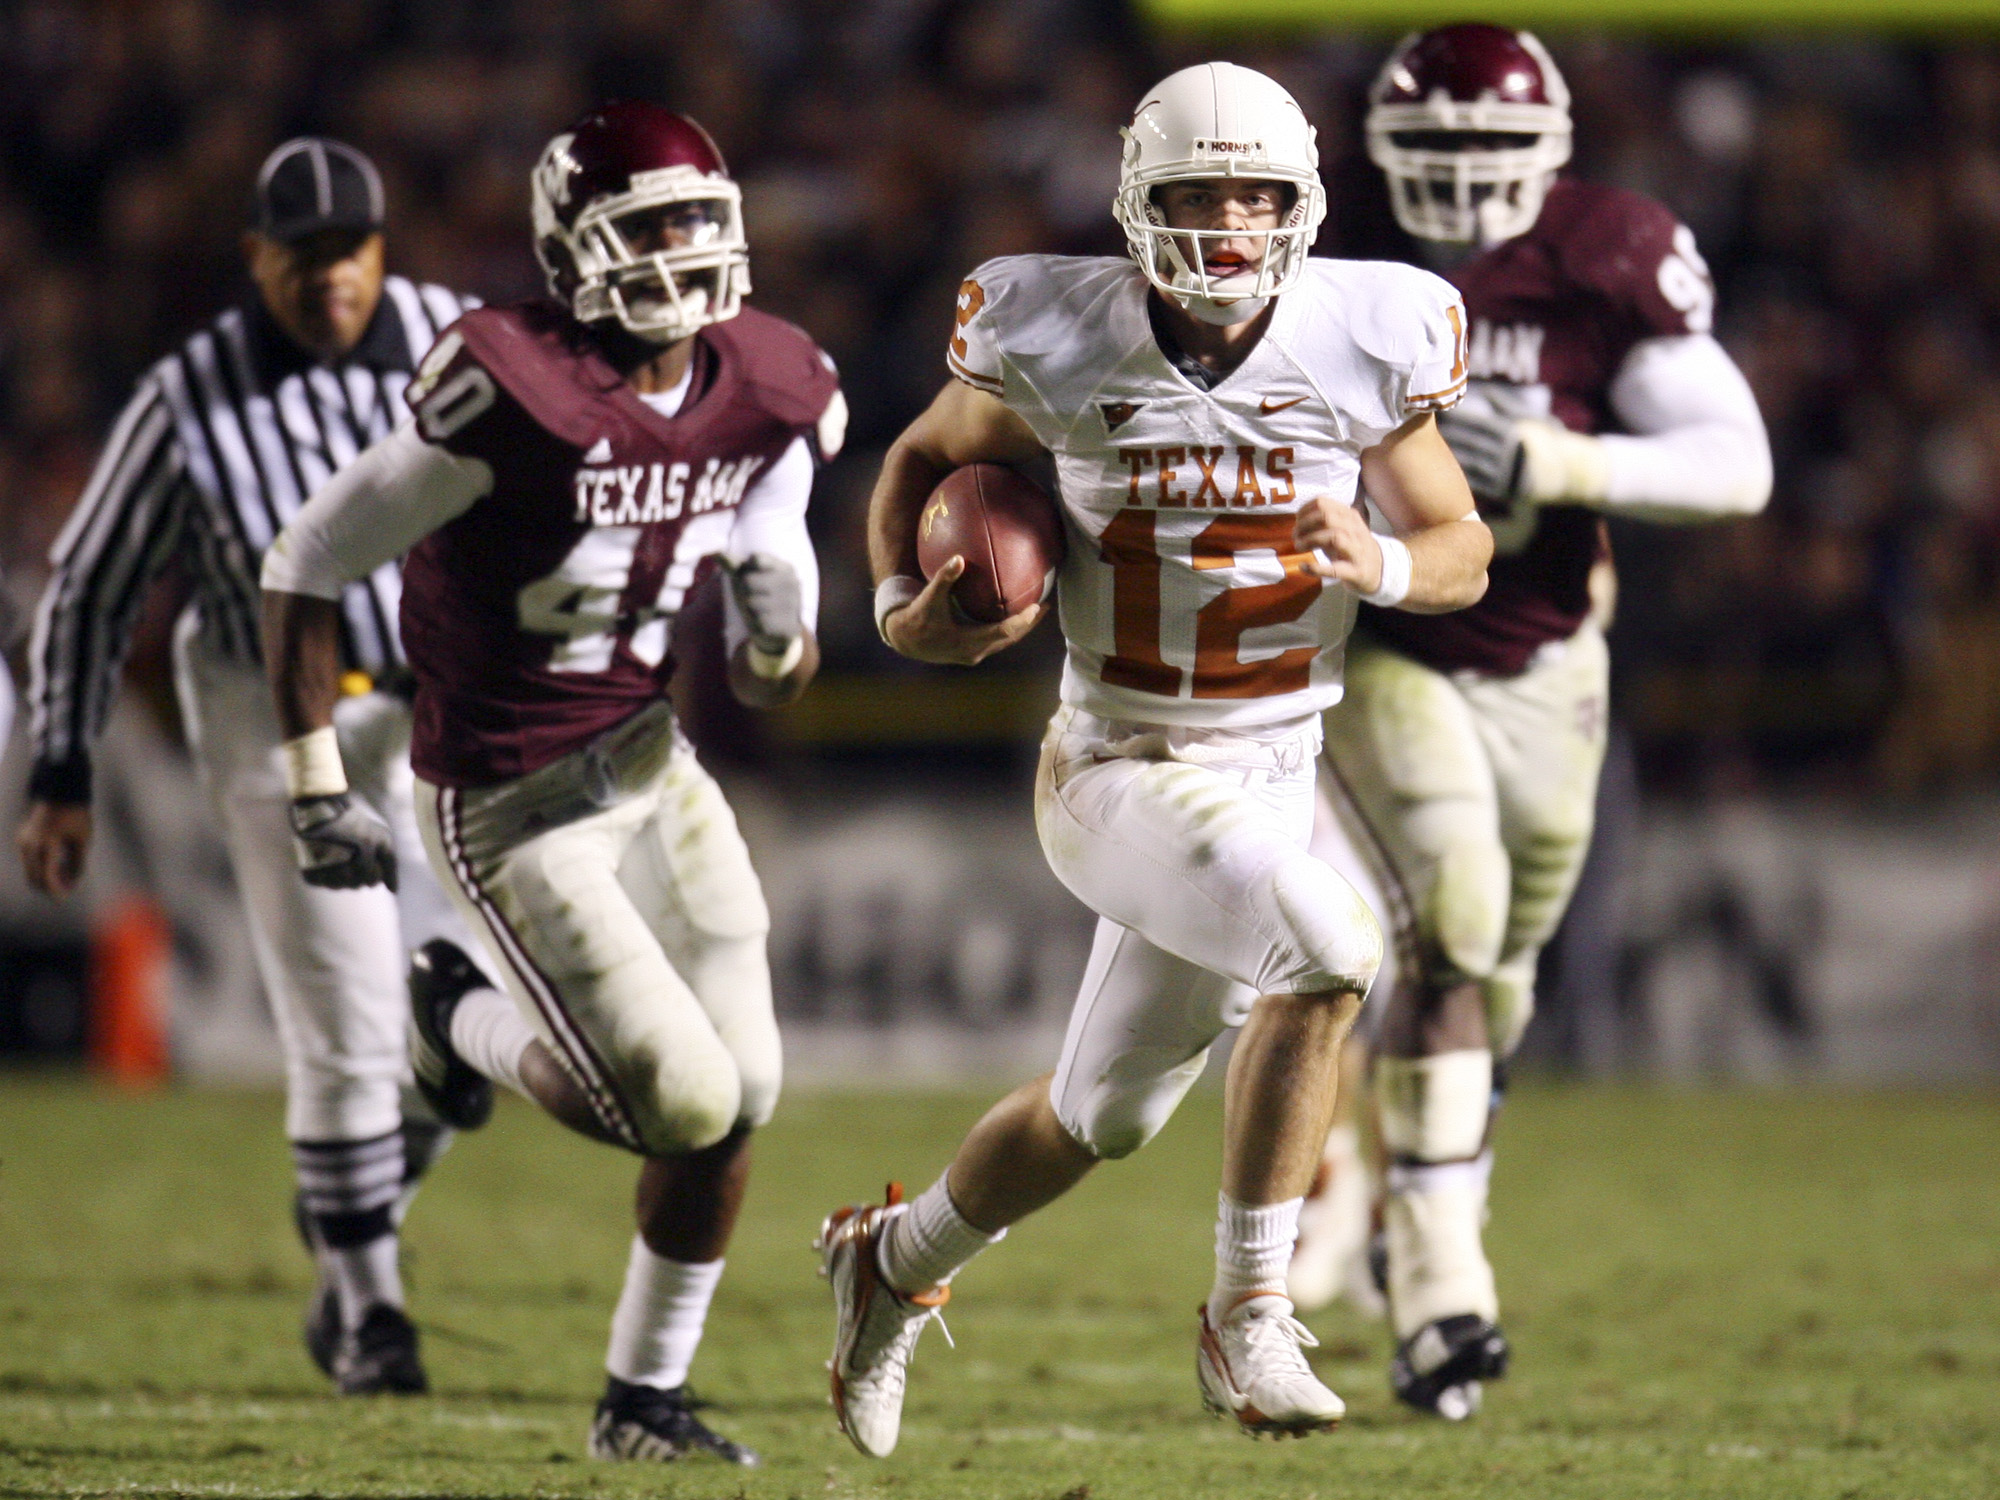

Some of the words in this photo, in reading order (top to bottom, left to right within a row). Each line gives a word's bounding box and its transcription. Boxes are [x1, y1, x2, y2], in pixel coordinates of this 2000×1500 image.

[1211, 141, 1249, 154] HORNS
[575, 462, 691, 526] TEXAS
[1119, 446, 1295, 508] TEXAS
[1100, 509, 1324, 699] 12
